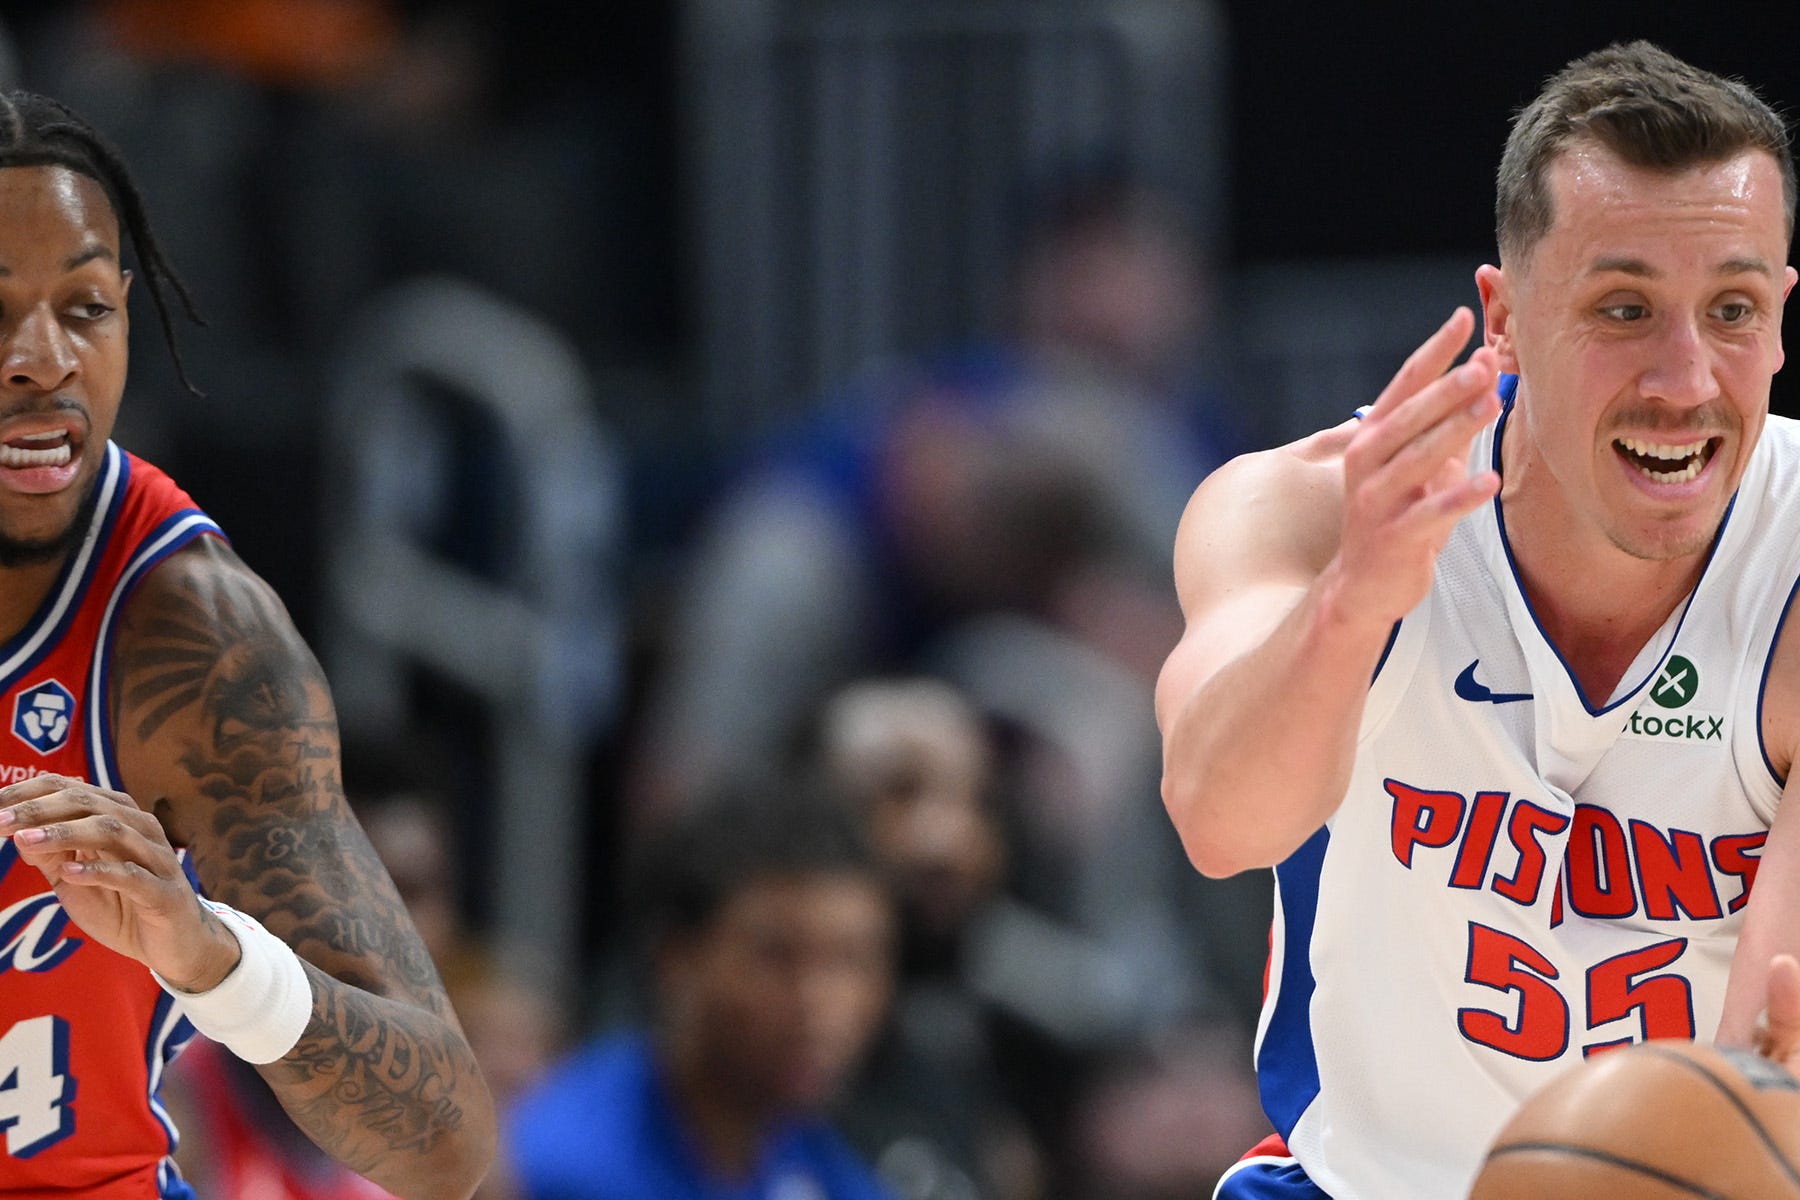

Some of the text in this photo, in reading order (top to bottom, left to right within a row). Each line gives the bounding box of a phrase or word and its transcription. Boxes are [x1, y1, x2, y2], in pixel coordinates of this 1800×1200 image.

[1621, 710, 1724, 741] tockX
[1383, 777, 1769, 929] PISONS
[1457, 921, 1696, 1062] 55
